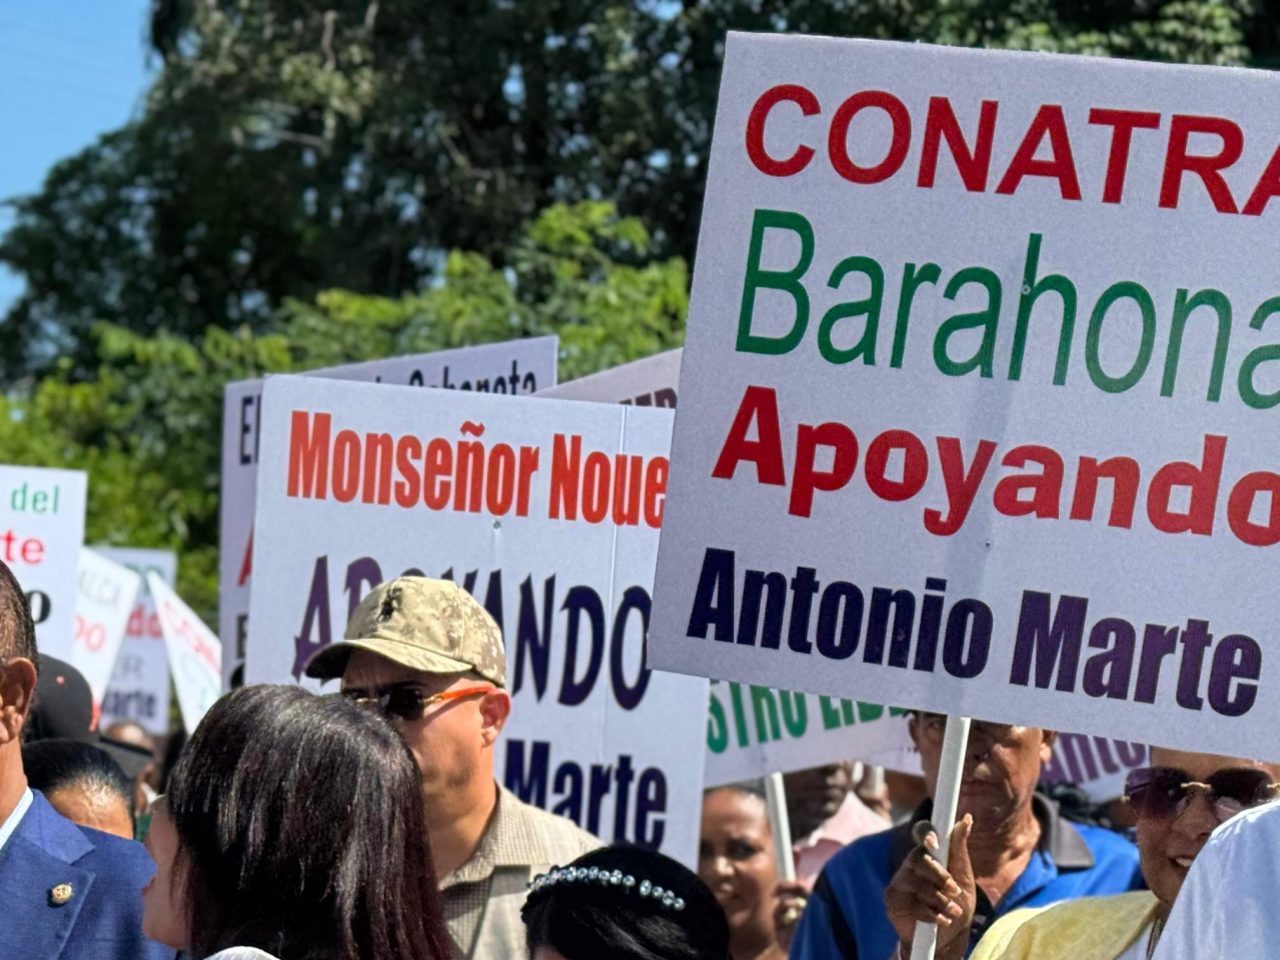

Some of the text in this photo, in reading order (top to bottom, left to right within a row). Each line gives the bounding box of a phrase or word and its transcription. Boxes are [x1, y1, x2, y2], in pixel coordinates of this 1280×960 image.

[11, 483, 60, 514] del
[287, 411, 540, 517] Monseñor
[712, 387, 1280, 546] Apoyando
[687, 548, 1262, 717] Antonio Marte
